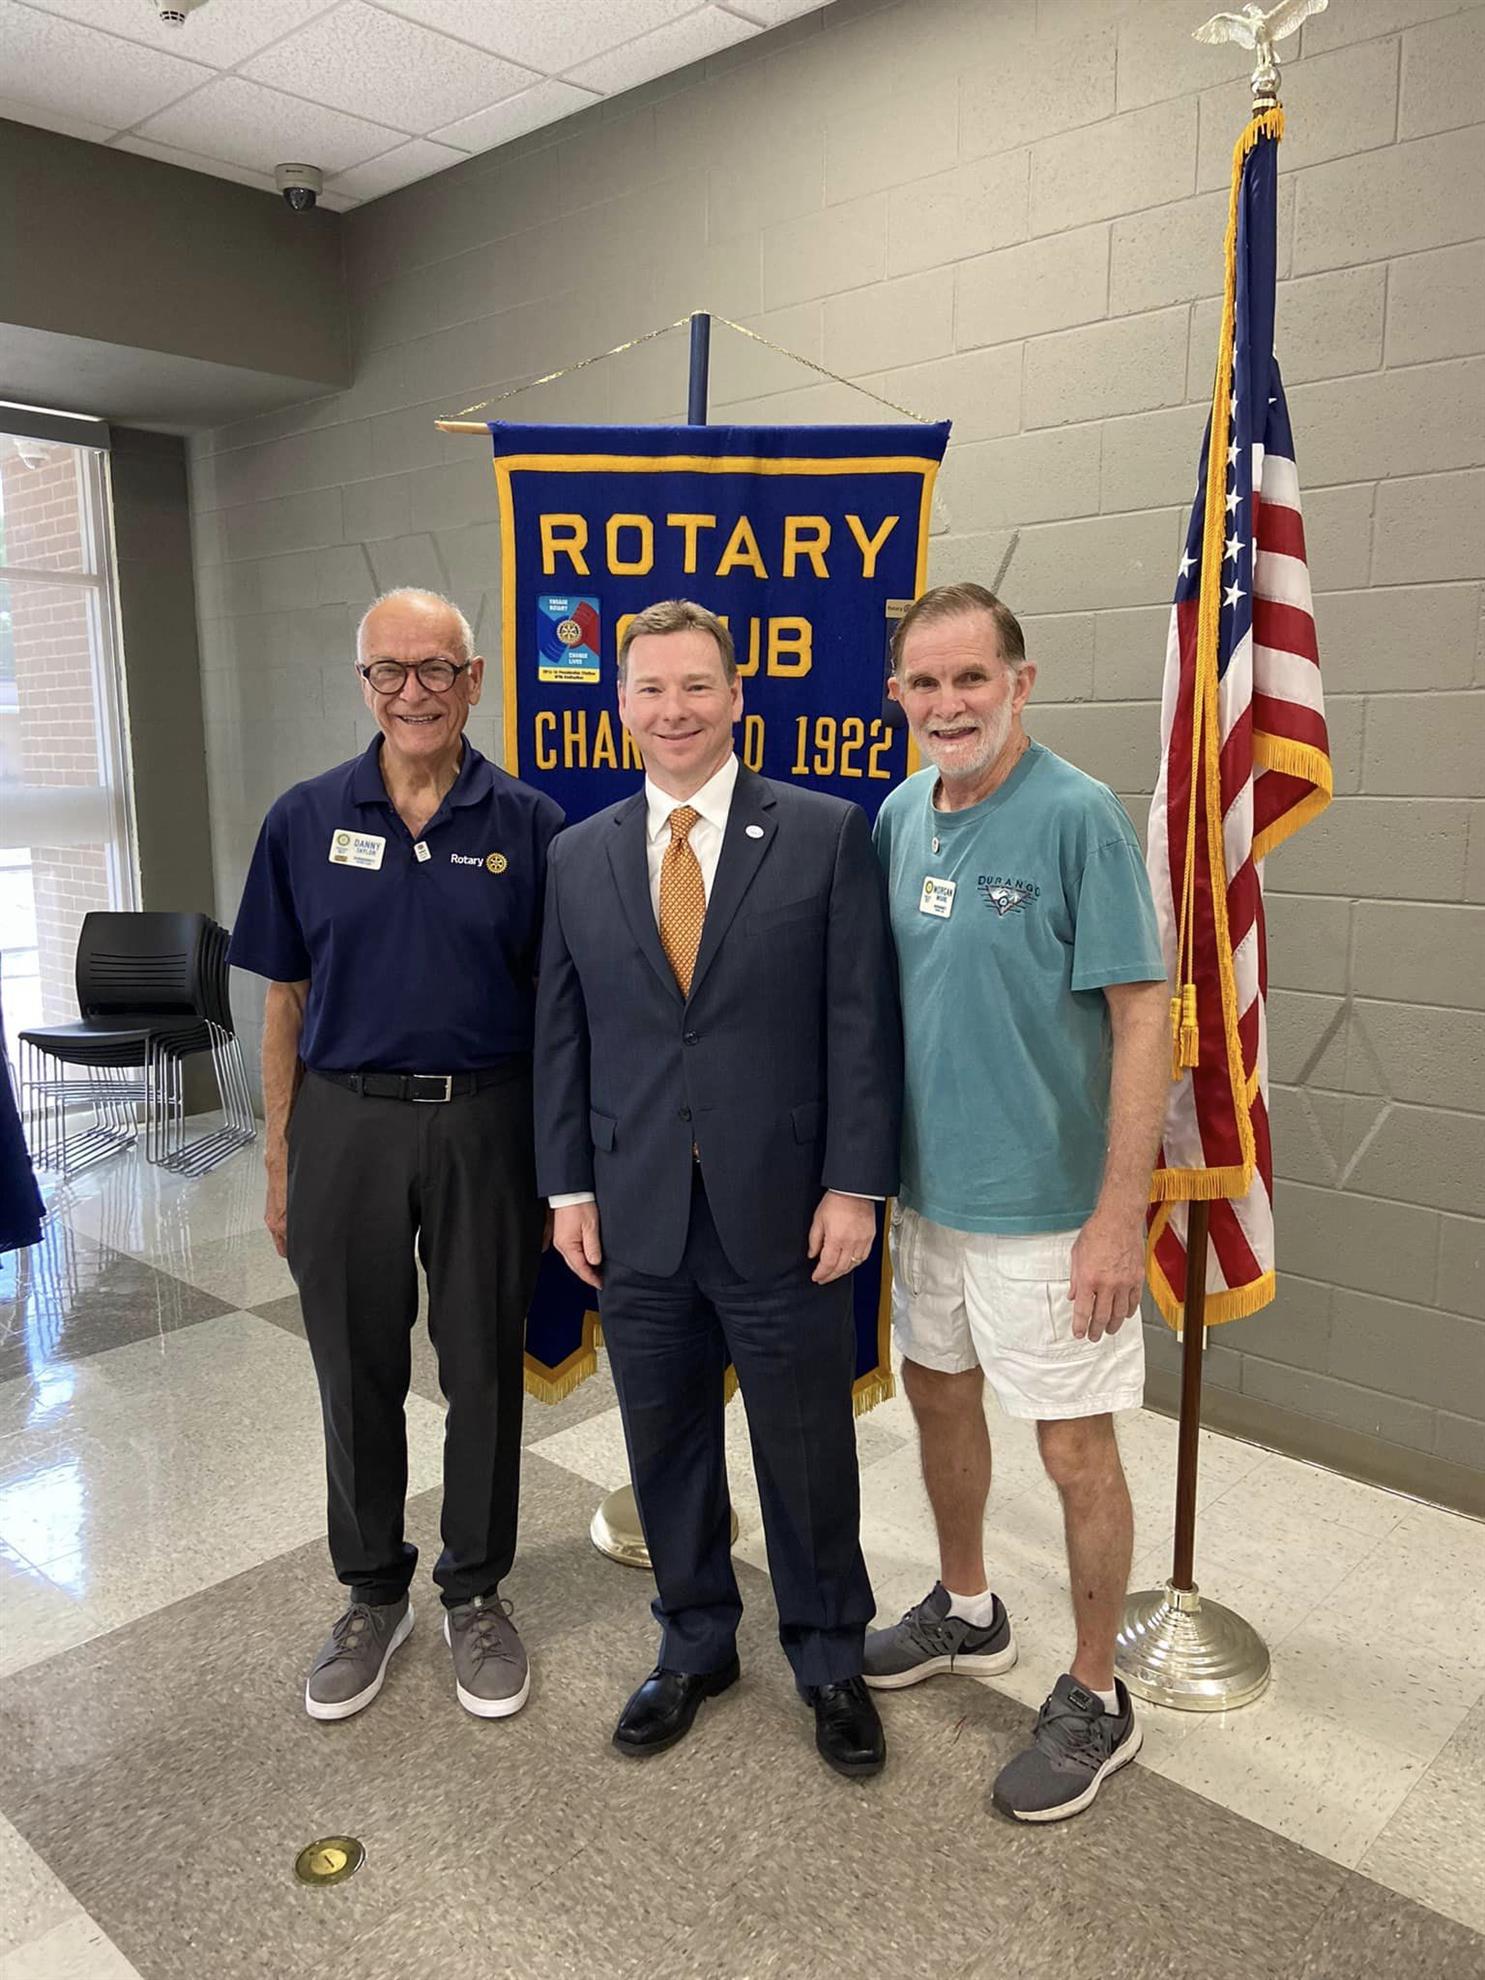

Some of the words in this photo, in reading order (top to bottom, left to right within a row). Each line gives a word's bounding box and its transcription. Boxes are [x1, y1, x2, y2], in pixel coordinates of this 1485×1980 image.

[539, 513, 899, 579] ROTARY
[616, 614, 813, 678] UB
[791, 715, 893, 779] 1922
[354, 838, 382, 850] DANNY
[450, 853, 484, 867] Rotary
[977, 875, 1040, 897] DURANGO
